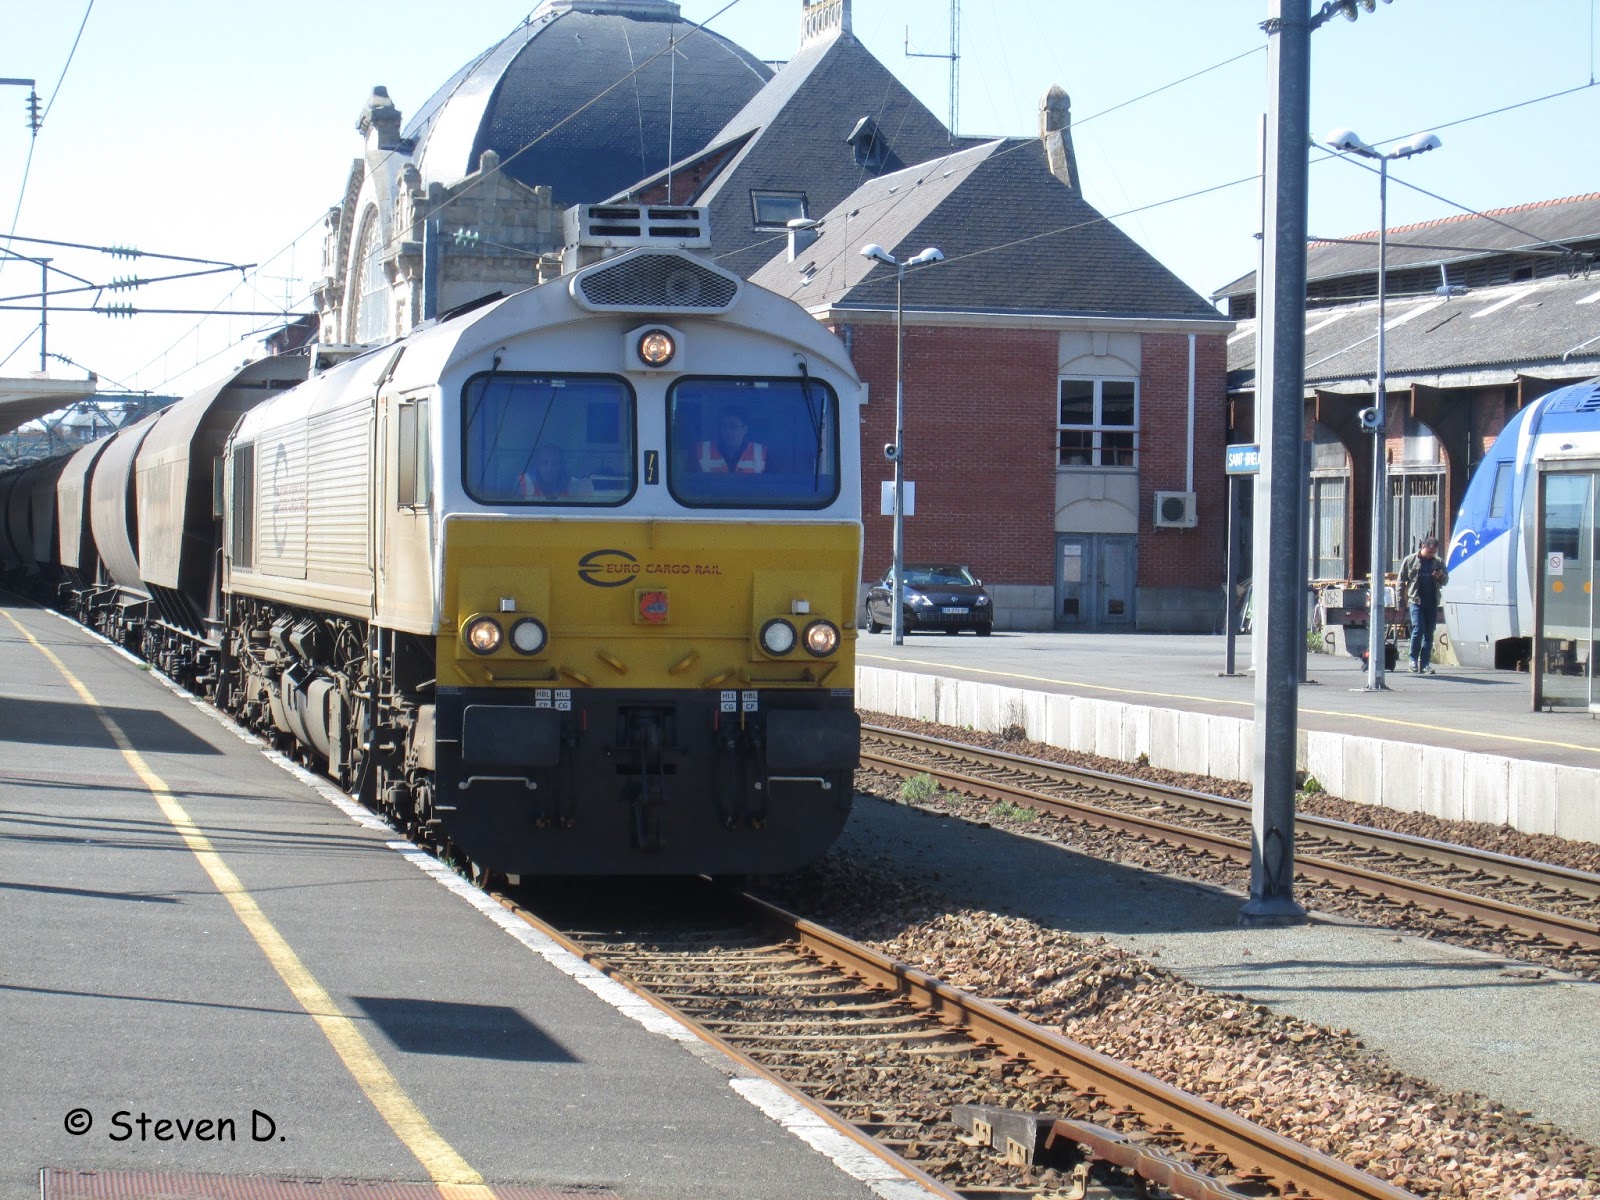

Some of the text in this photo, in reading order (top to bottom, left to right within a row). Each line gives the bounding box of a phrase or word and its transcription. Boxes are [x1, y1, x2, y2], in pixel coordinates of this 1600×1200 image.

[1228, 452, 1260, 467] SAINT-BRIEU
[606, 563, 722, 575] EURO CARGO RAIL
[722, 692, 736, 700] HLL
[743, 692, 757, 700] HBL
[723, 703, 734, 711] CG
